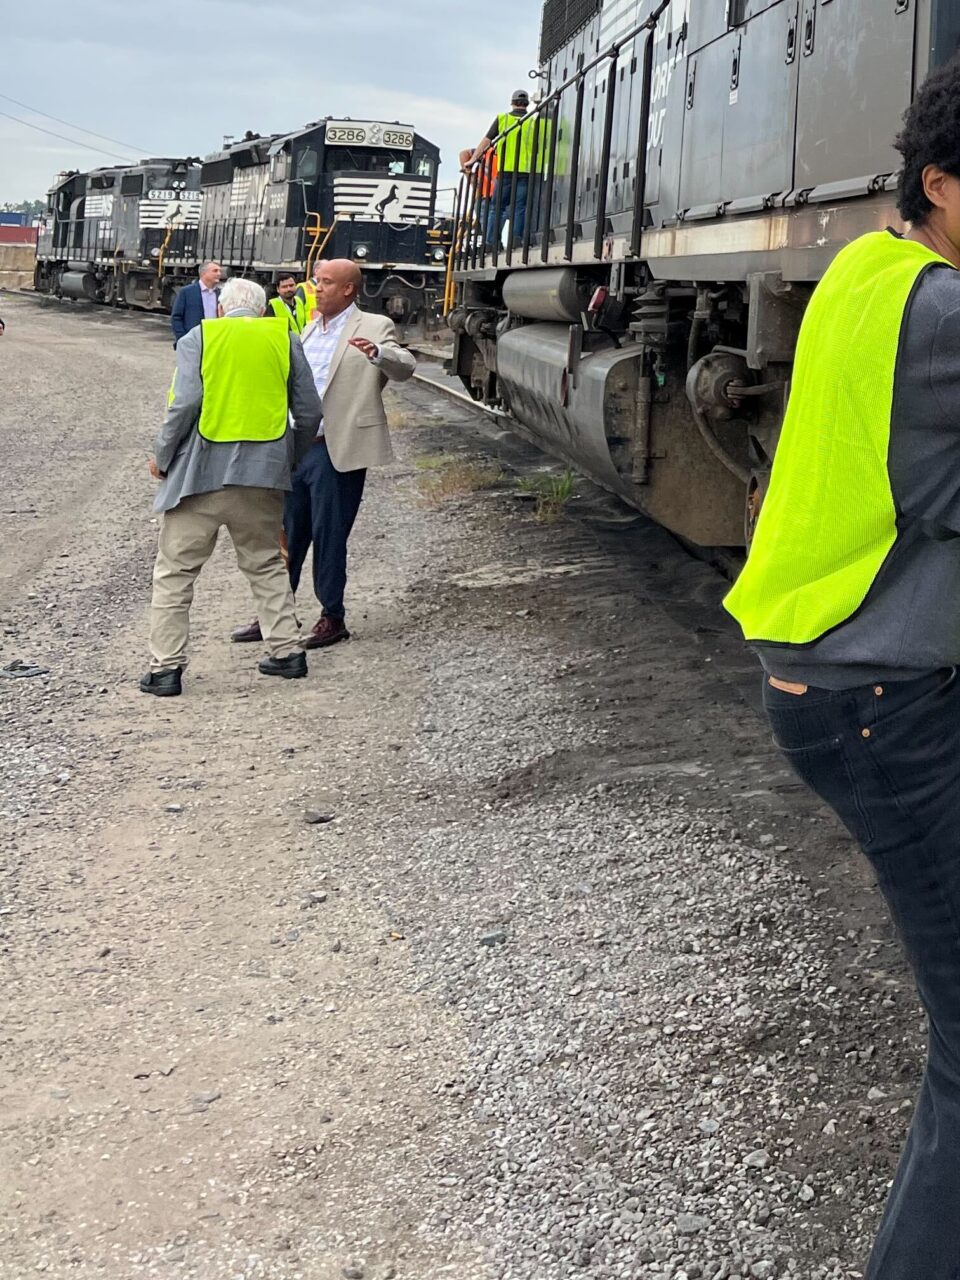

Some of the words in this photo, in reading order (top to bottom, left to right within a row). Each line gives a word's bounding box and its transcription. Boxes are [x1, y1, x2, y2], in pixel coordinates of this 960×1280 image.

[328, 129, 366, 142] 3286
[385, 131, 413, 146] 3286
[150, 190, 173, 199] 5219
